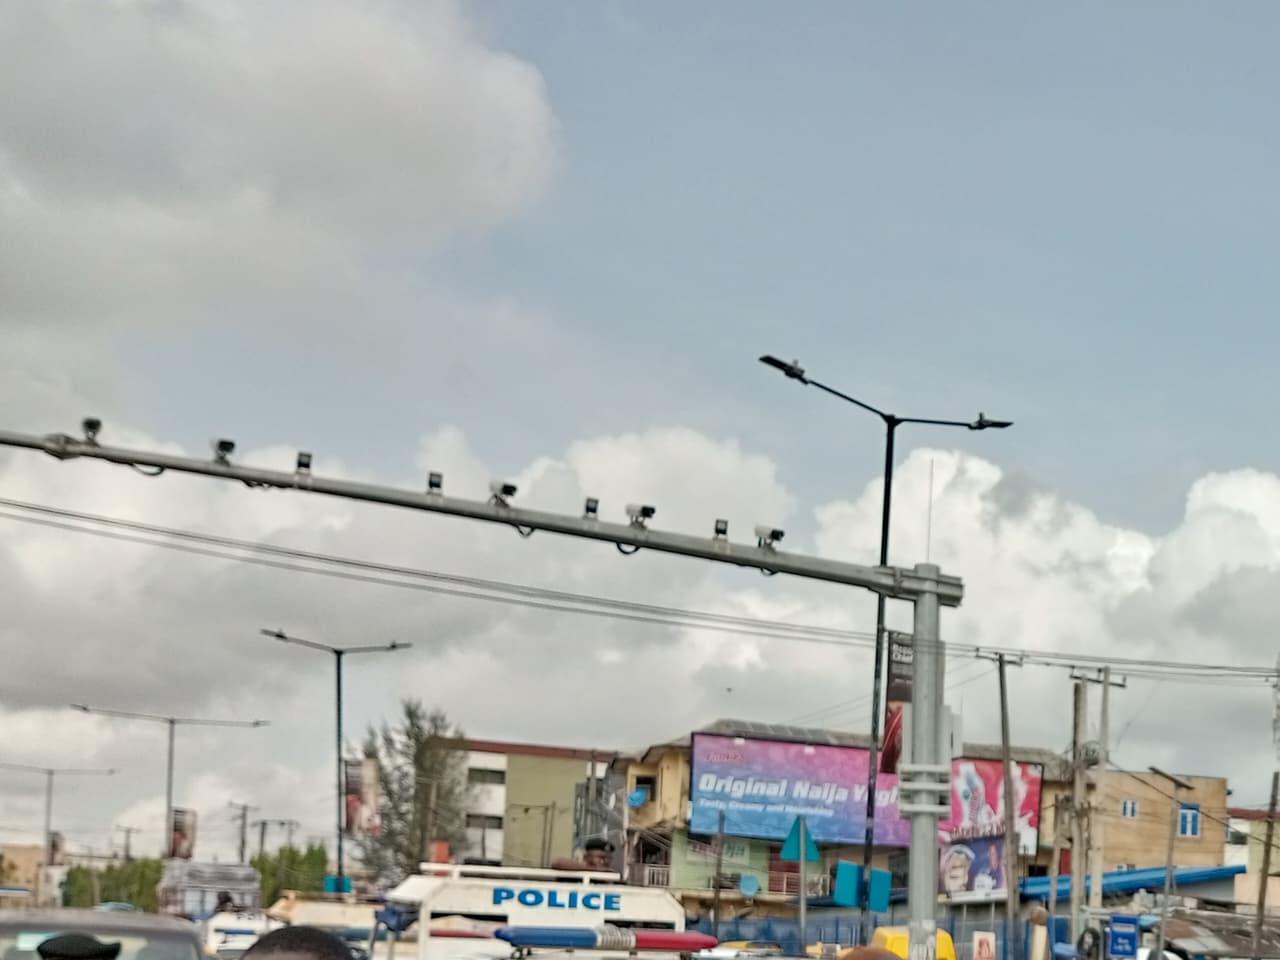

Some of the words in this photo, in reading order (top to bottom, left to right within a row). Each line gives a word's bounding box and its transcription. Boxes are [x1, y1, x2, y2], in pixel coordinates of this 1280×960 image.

[699, 773, 787, 799] Original
[793, 780, 849, 804] Naija
[492, 887, 621, 911] POLICE
